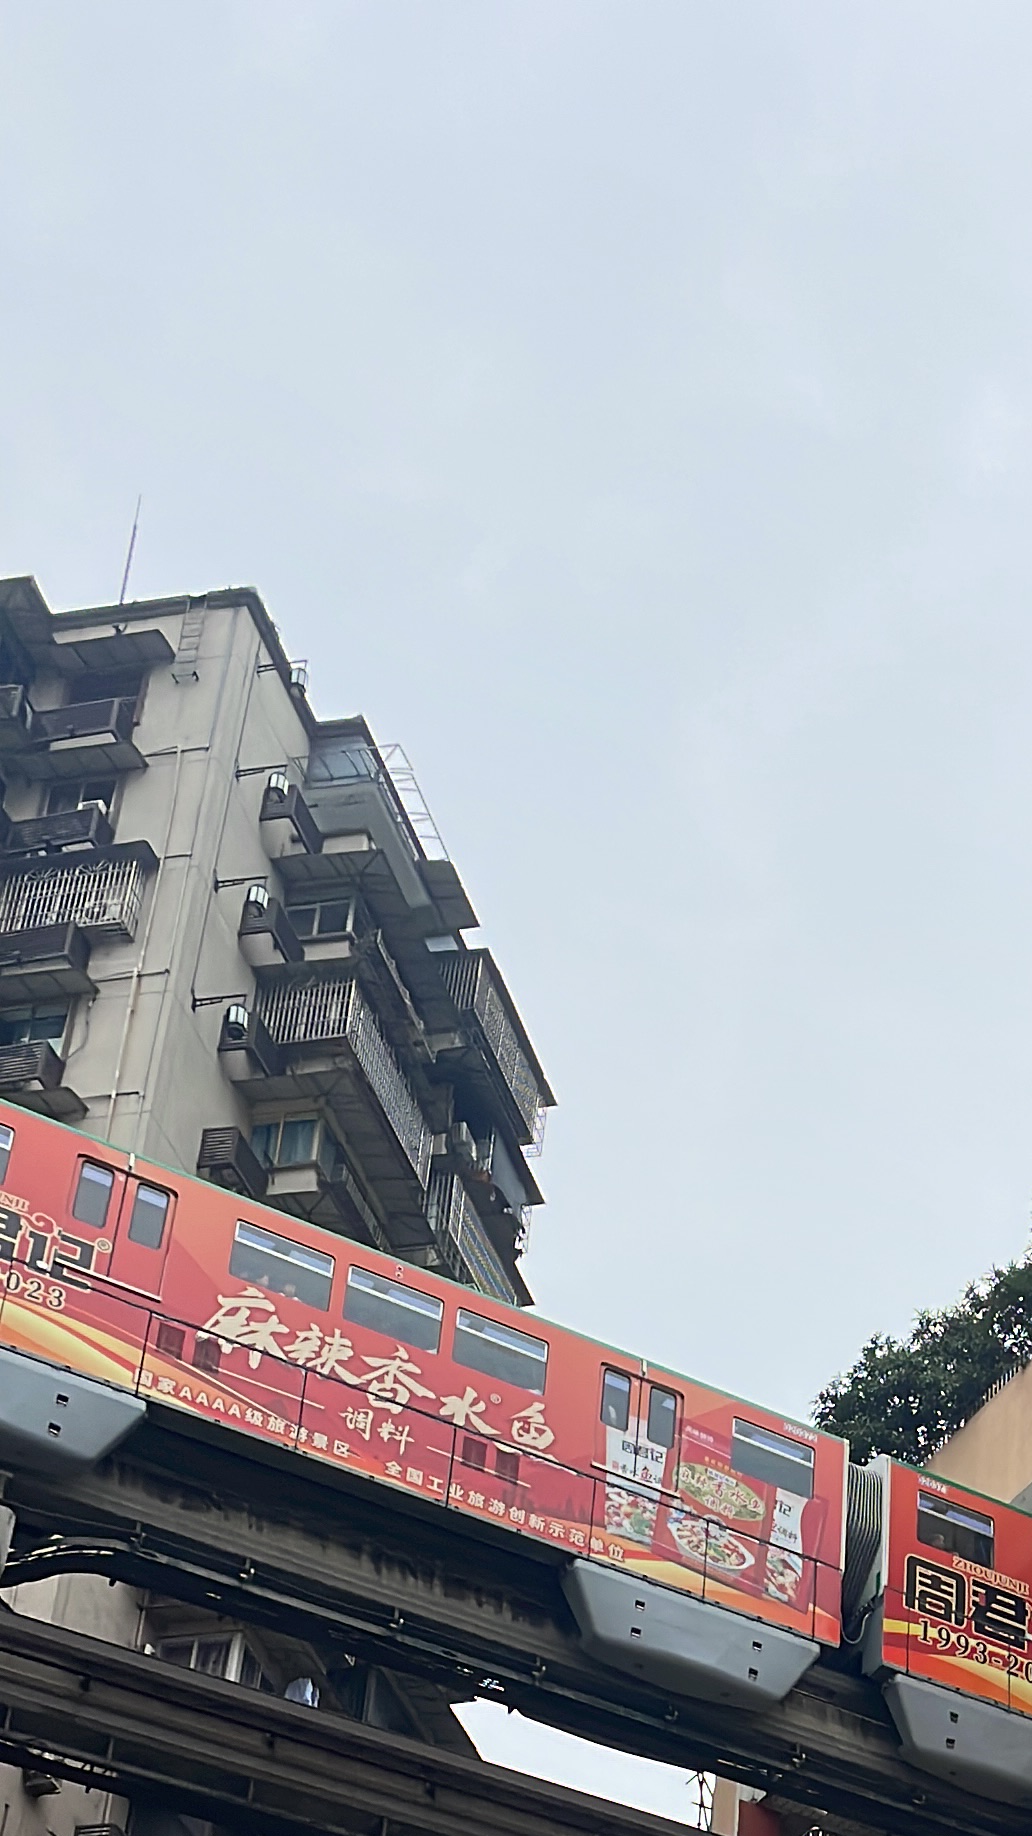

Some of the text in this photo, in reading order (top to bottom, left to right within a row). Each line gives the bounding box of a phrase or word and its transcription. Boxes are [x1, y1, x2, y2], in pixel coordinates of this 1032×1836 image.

[0, 1268, 64, 1309] 023
[196, 1287, 560, 1462] 麻辣香水鱼
[133, 1367, 350, 1458] 国家AAAA级旅游景区
[338, 1406, 415, 1455] 调料
[384, 1460, 625, 1563] 全国工业旅游创新示范单位
[952, 1555, 1029, 1594] ZHOUJUNJI
